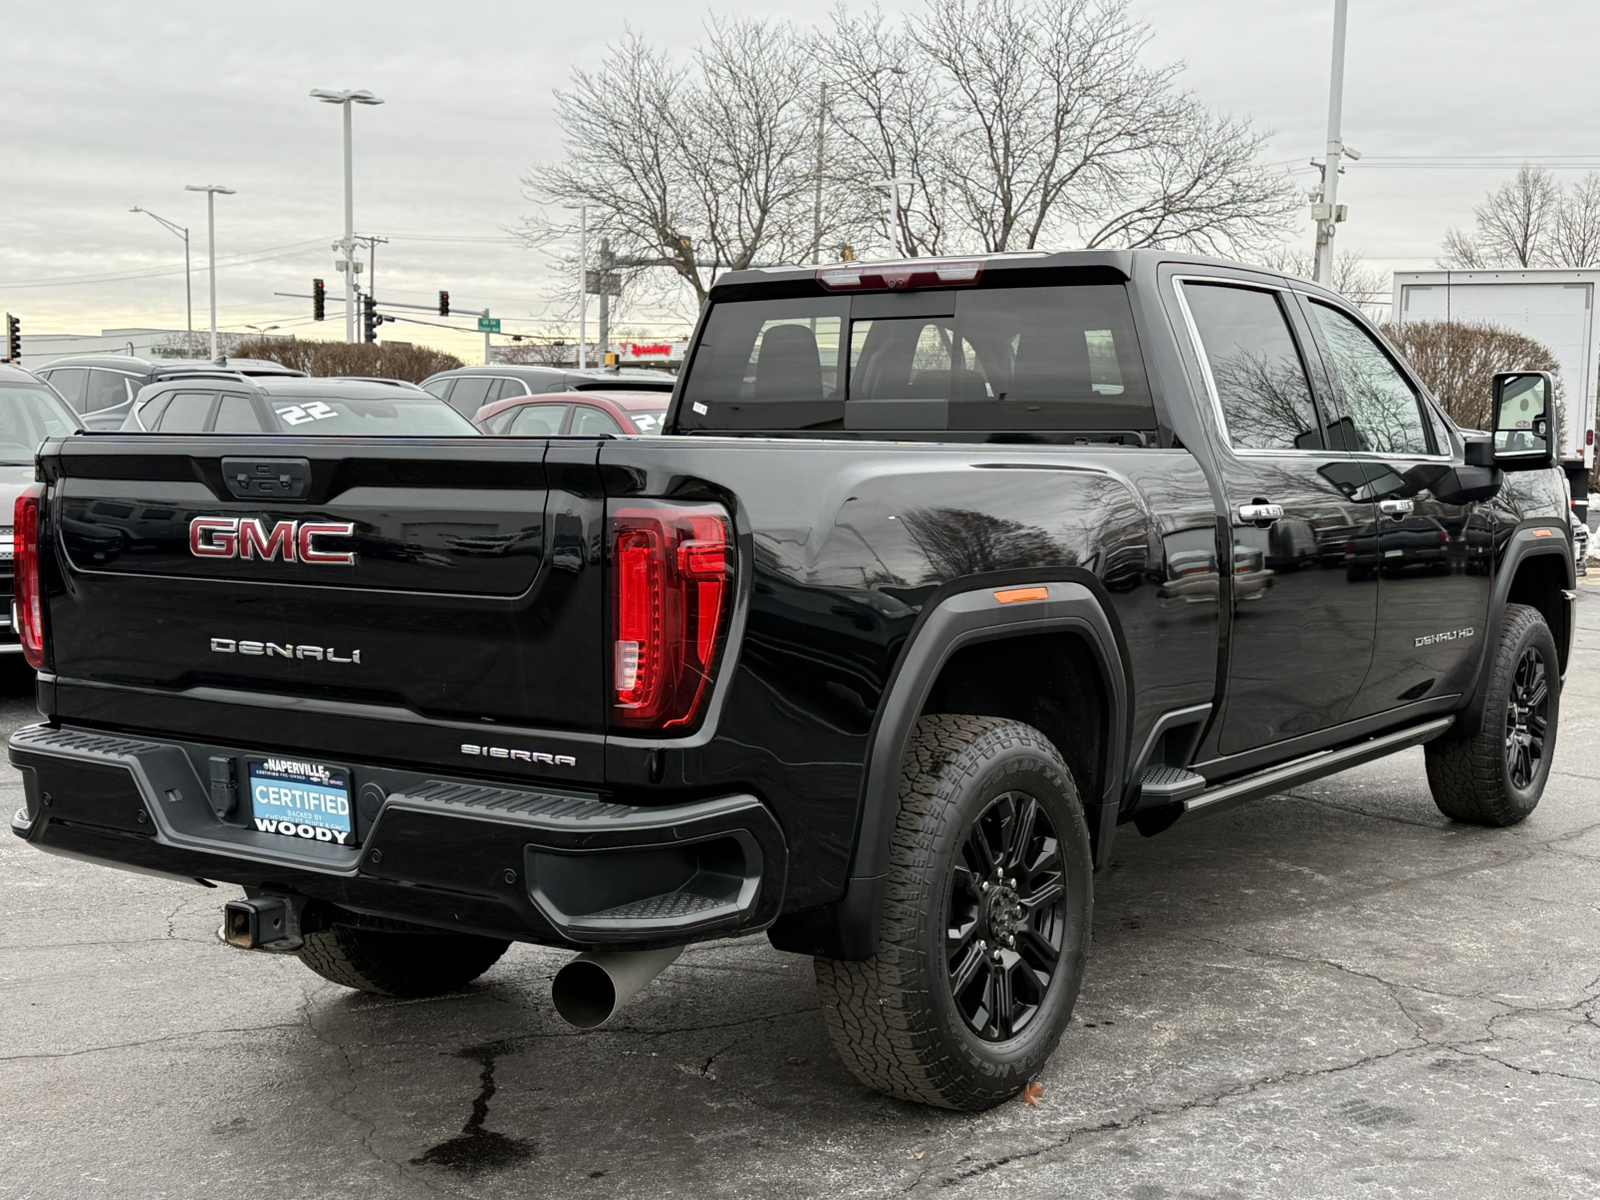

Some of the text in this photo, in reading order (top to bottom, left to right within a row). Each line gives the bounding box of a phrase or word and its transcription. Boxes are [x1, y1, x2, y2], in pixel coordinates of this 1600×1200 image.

[275, 401, 338, 426] 22
[189, 515, 356, 566] GMC
[1413, 627, 1474, 647] DENALI HD
[210, 637, 361, 664] DENALI
[461, 743, 576, 766] SIERRA
[267, 758, 325, 778] NAPERVILLE
[255, 785, 349, 816] CERTIFIED
[286, 810, 313, 820] BACKED
[254, 818, 349, 844] WOODY
